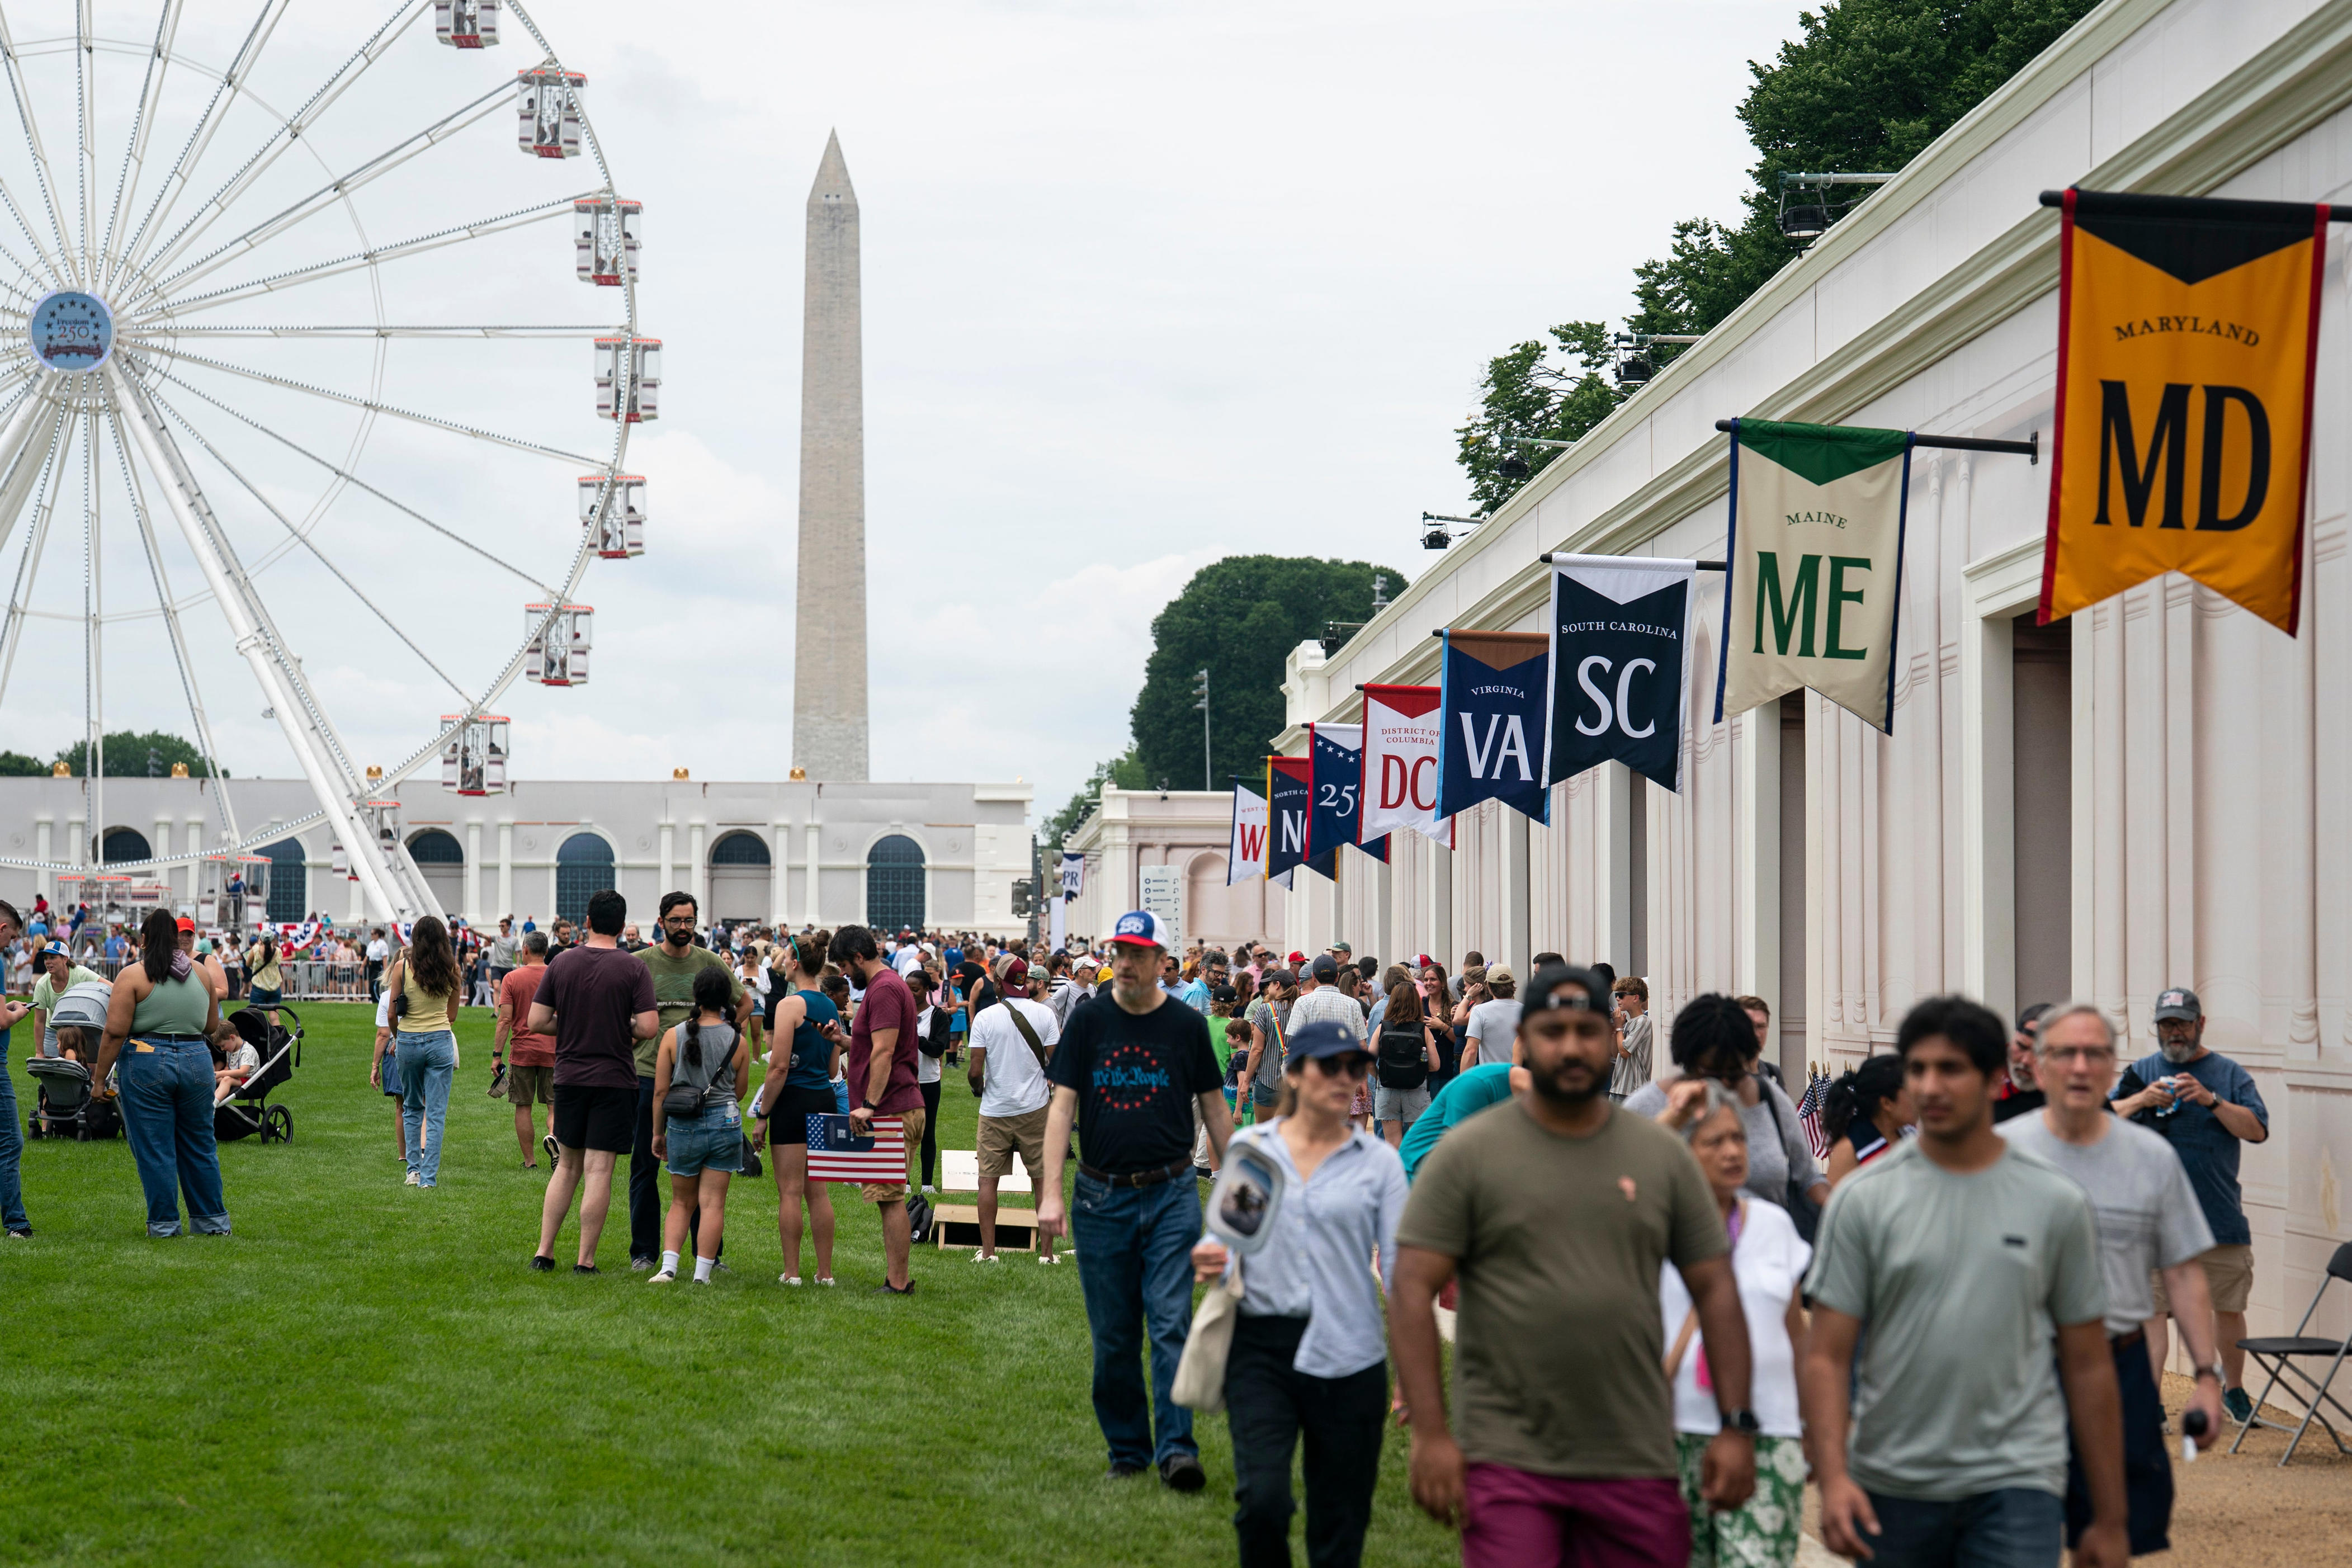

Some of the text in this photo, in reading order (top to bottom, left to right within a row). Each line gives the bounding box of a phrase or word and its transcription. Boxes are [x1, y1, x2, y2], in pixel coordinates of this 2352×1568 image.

[58, 325, 89, 343] 250
[2114, 315, 2260, 347] MARYLAND
[2093, 379, 2271, 532] MD
[1785, 511, 1848, 529] MAINE
[1753, 551, 1872, 660] ME
[1561, 621, 1677, 640] SOUTH CAROLINA
[1471, 685, 1525, 699] VIRGINIA
[1574, 655, 1657, 739] SC
[1381, 728, 1426, 736] DISTRICT
[1386, 736, 1435, 745] COLUMBIA
[1458, 712, 1534, 781] VA
[1274, 789, 1298, 799] NORTH
[1379, 754, 1437, 811] DC
[1319, 783, 1361, 818] 25
[1281, 809, 1307, 853] N
[1062, 870, 1079, 887] PR
